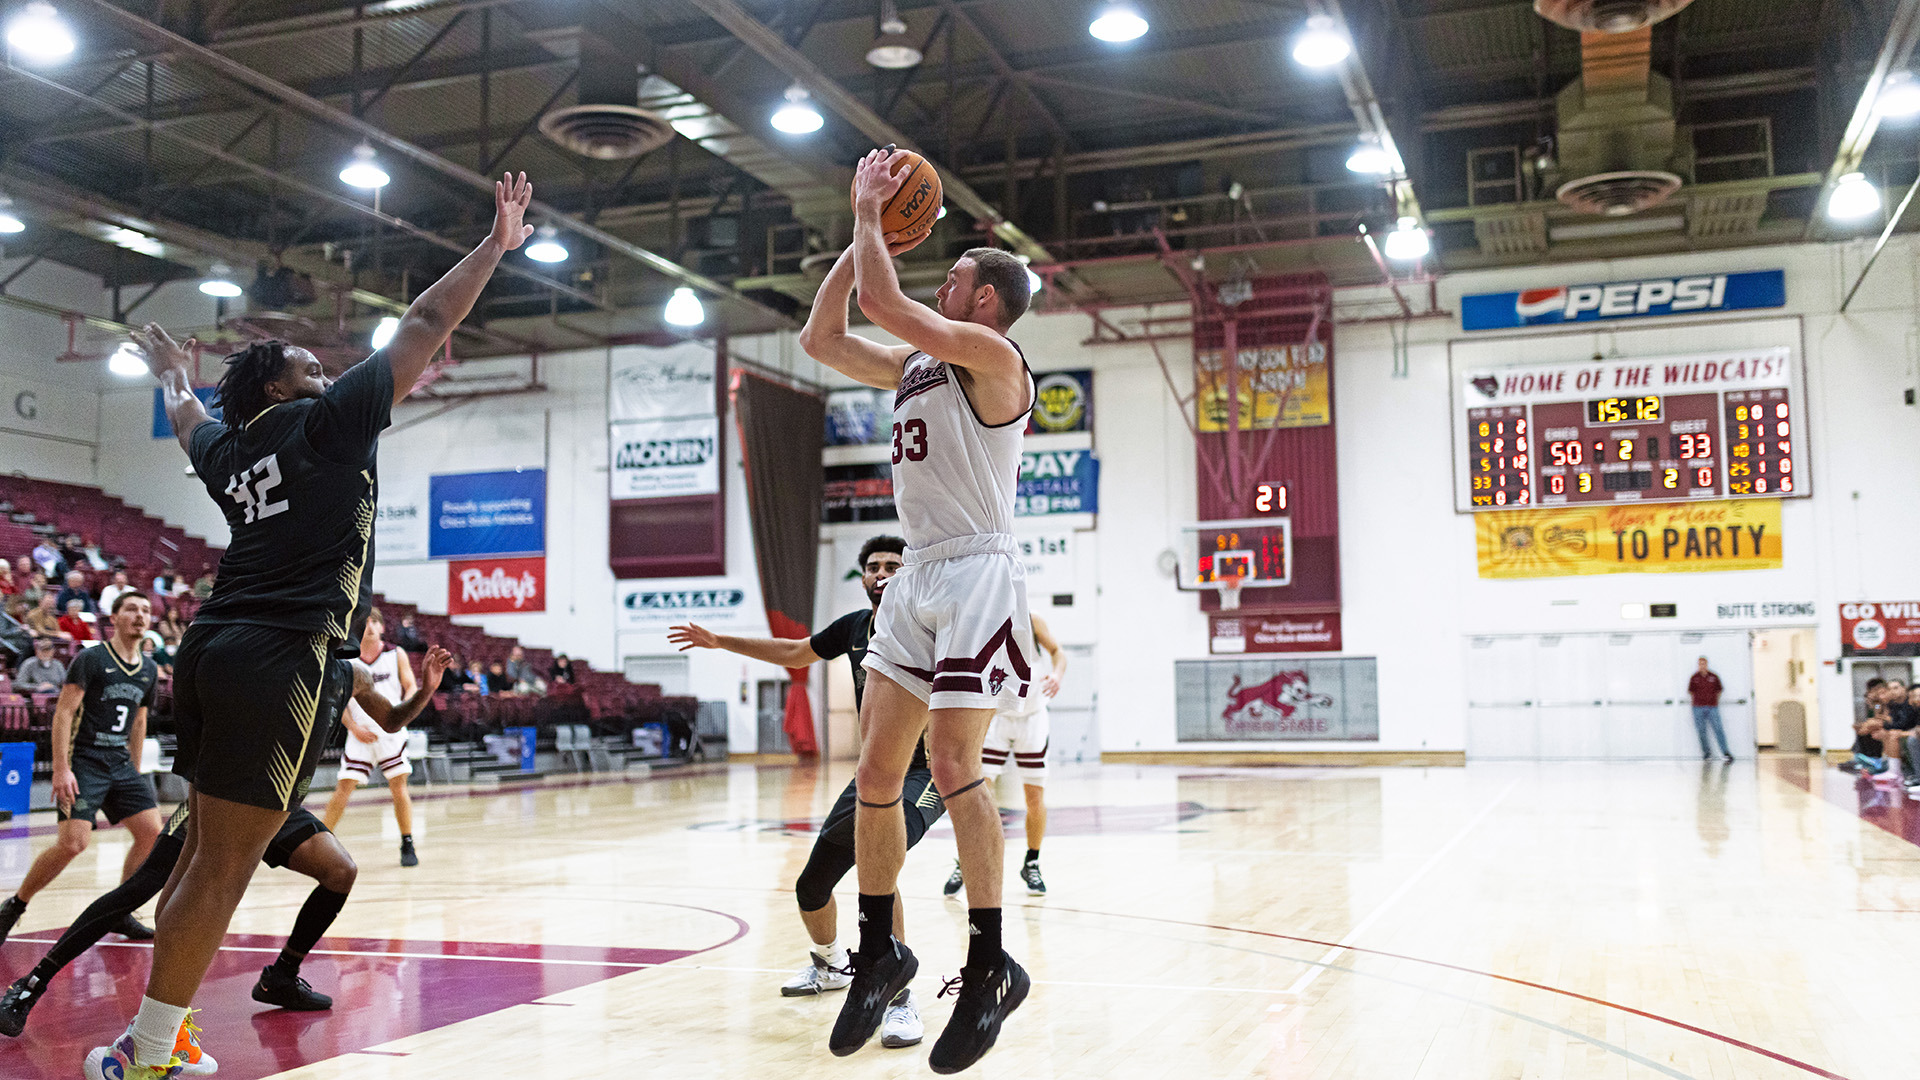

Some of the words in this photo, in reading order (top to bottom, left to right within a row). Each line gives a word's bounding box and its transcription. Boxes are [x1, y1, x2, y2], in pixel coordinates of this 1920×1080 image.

[900, 178, 932, 219] NCAA
[1565, 275, 1728, 319] PEPSI
[1504, 373, 1563, 394] HOME
[1576, 369, 1604, 391] OF
[1613, 366, 1653, 388] THE
[1663, 357, 1785, 385] WILDCATS!
[14, 389, 37, 420] G
[1598, 396, 1659, 423] 15:12
[1516, 418, 1527, 435] 2
[1738, 424, 1749, 440] 3
[891, 418, 928, 465] 33
[1480, 442, 1490, 453] 4
[1618, 439, 1633, 461] 2
[1679, 433, 1711, 459] 33
[1777, 441, 1791, 454] 4
[617, 438, 712, 468] MODERN
[1480, 457, 1491, 471] 5
[1512, 454, 1528, 469] 12
[1550, 440, 1583, 466] 50
[1663, 468, 1678, 489] 2
[1697, 466, 1713, 487] 0
[1729, 462, 1751, 477] 25
[224, 453, 289, 525] 42
[1473, 476, 1491, 489] 33
[1519, 472, 1529, 486] 7
[1551, 474, 1564, 494] 0
[1578, 472, 1592, 493] 3
[1730, 481, 1752, 494] 42
[1780, 476, 1793, 492] 6
[1051, 496, 1080, 511] FM
[1256, 484, 1287, 511] 21
[1518, 489, 1530, 505] 2
[1039, 537, 1066, 555] 1st
[1612, 529, 1649, 562] TO
[1662, 524, 1766, 560] PARTY
[459, 567, 536, 608] Raley's
[633, 590, 733, 608] LAMAR
[1717, 603, 1756, 618] BUTTE
[1762, 601, 1816, 618] STRONG
[1842, 604, 1876, 620] GO
[1881, 603, 1920, 619] WIL
[111, 705, 129, 732] 3
